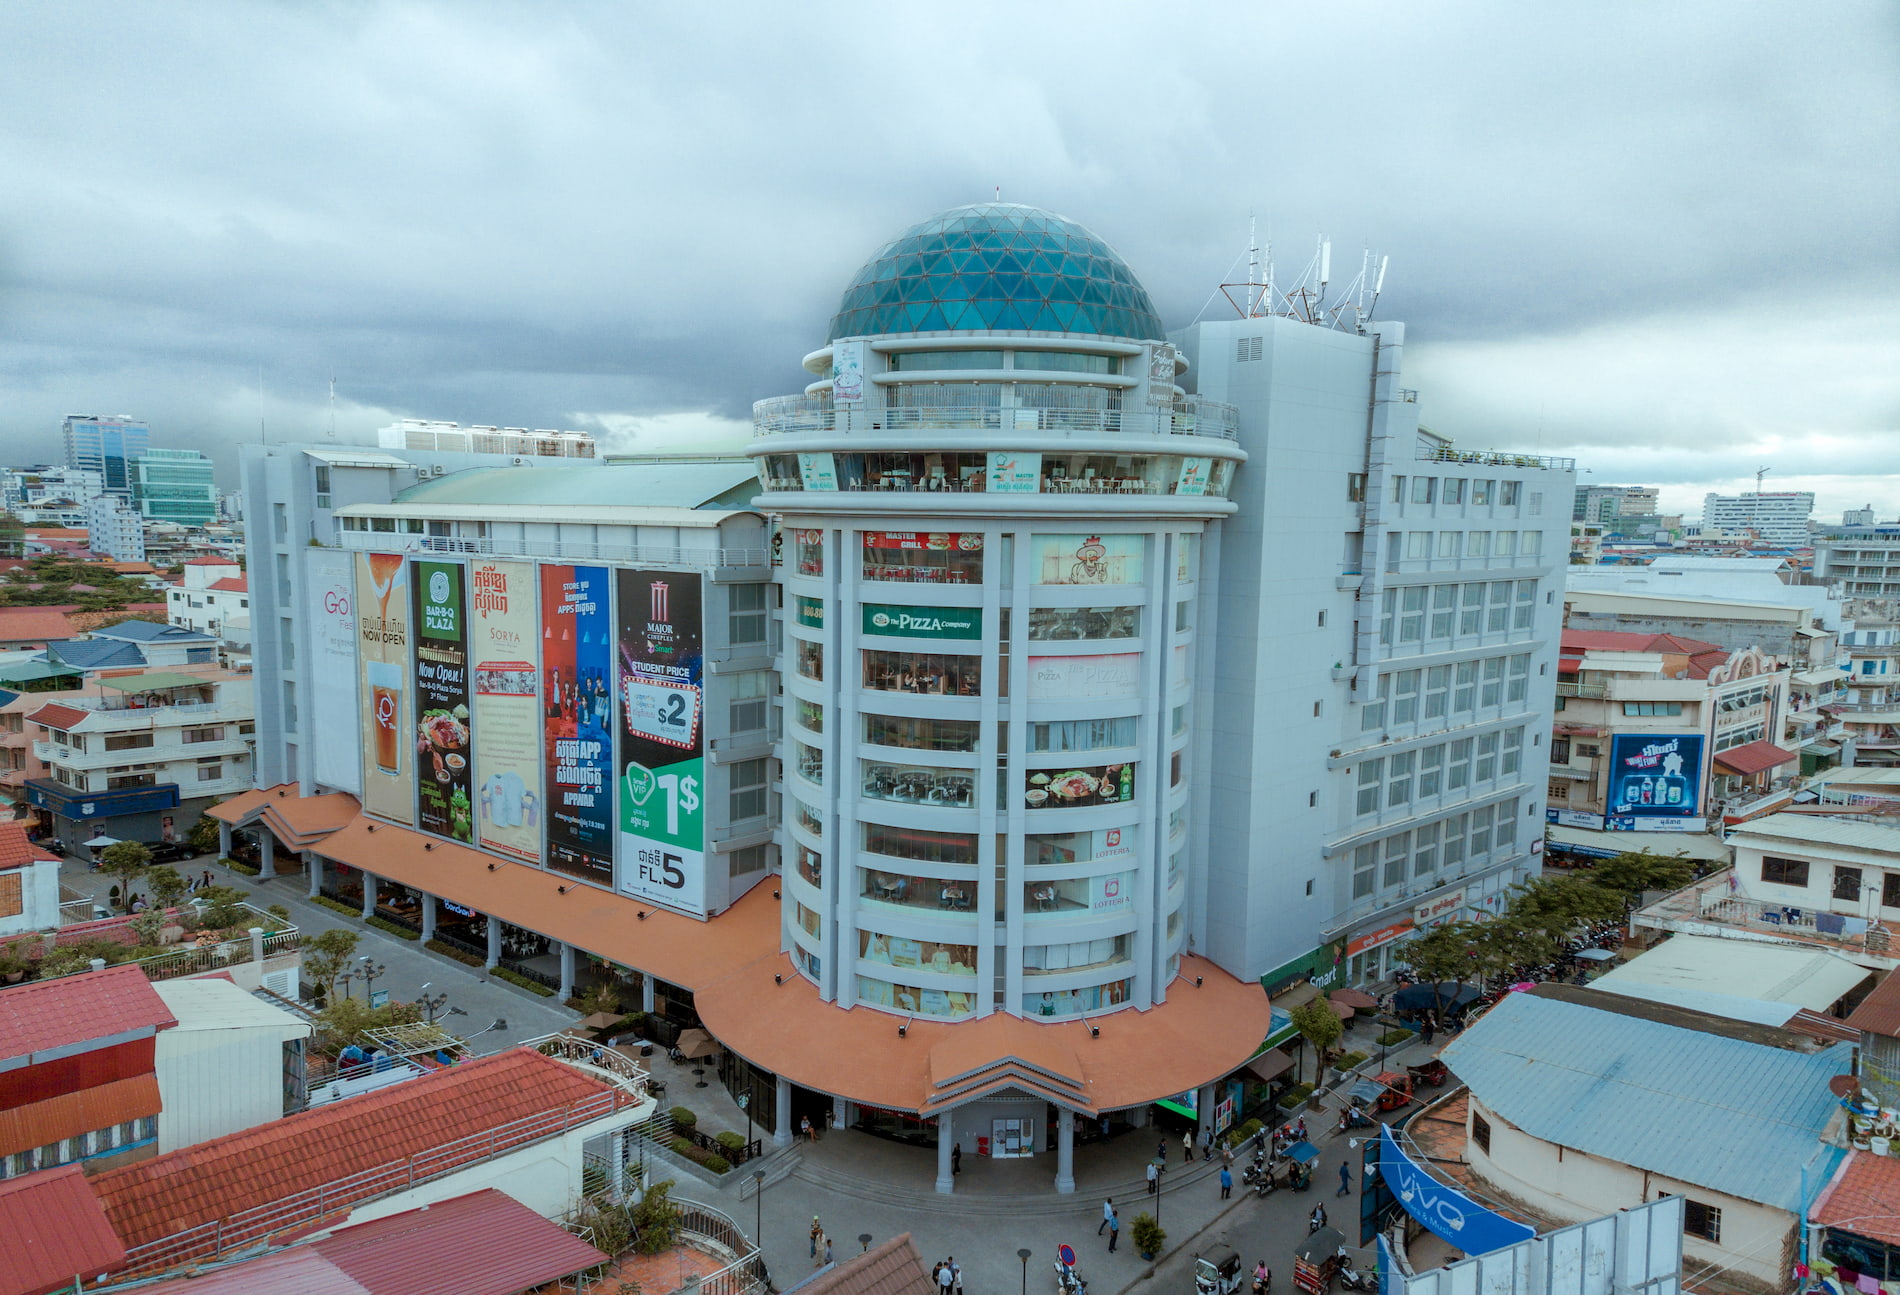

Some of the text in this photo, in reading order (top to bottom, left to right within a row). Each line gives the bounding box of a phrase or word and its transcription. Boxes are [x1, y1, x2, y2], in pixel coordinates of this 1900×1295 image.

[885, 532, 916, 540] MASTER
[900, 541, 922, 549] GRILL
[563, 582, 580, 591] STORE
[558, 604, 574, 614] APPS
[426, 617, 454, 631] PLAZA
[899, 614, 942, 630] PIZZA
[941, 620, 971, 629] Company
[647, 623, 673, 634] MAJOR
[363, 630, 380, 642] NOW
[382, 633, 405, 645] OPEN
[647, 633, 673, 642] CINEPLEX
[655, 644, 672, 653] Smart
[419, 662, 434, 678] Now
[631, 660, 690, 678] STUDENT PRICE
[633, 784, 646, 794] VIP
[1095, 847, 1130, 858] LOTTERIA
[1094, 896, 1130, 909] LOTTERIA
[1310, 965, 1337, 989] Smart
[1429, 1217, 1454, 1238] Music
